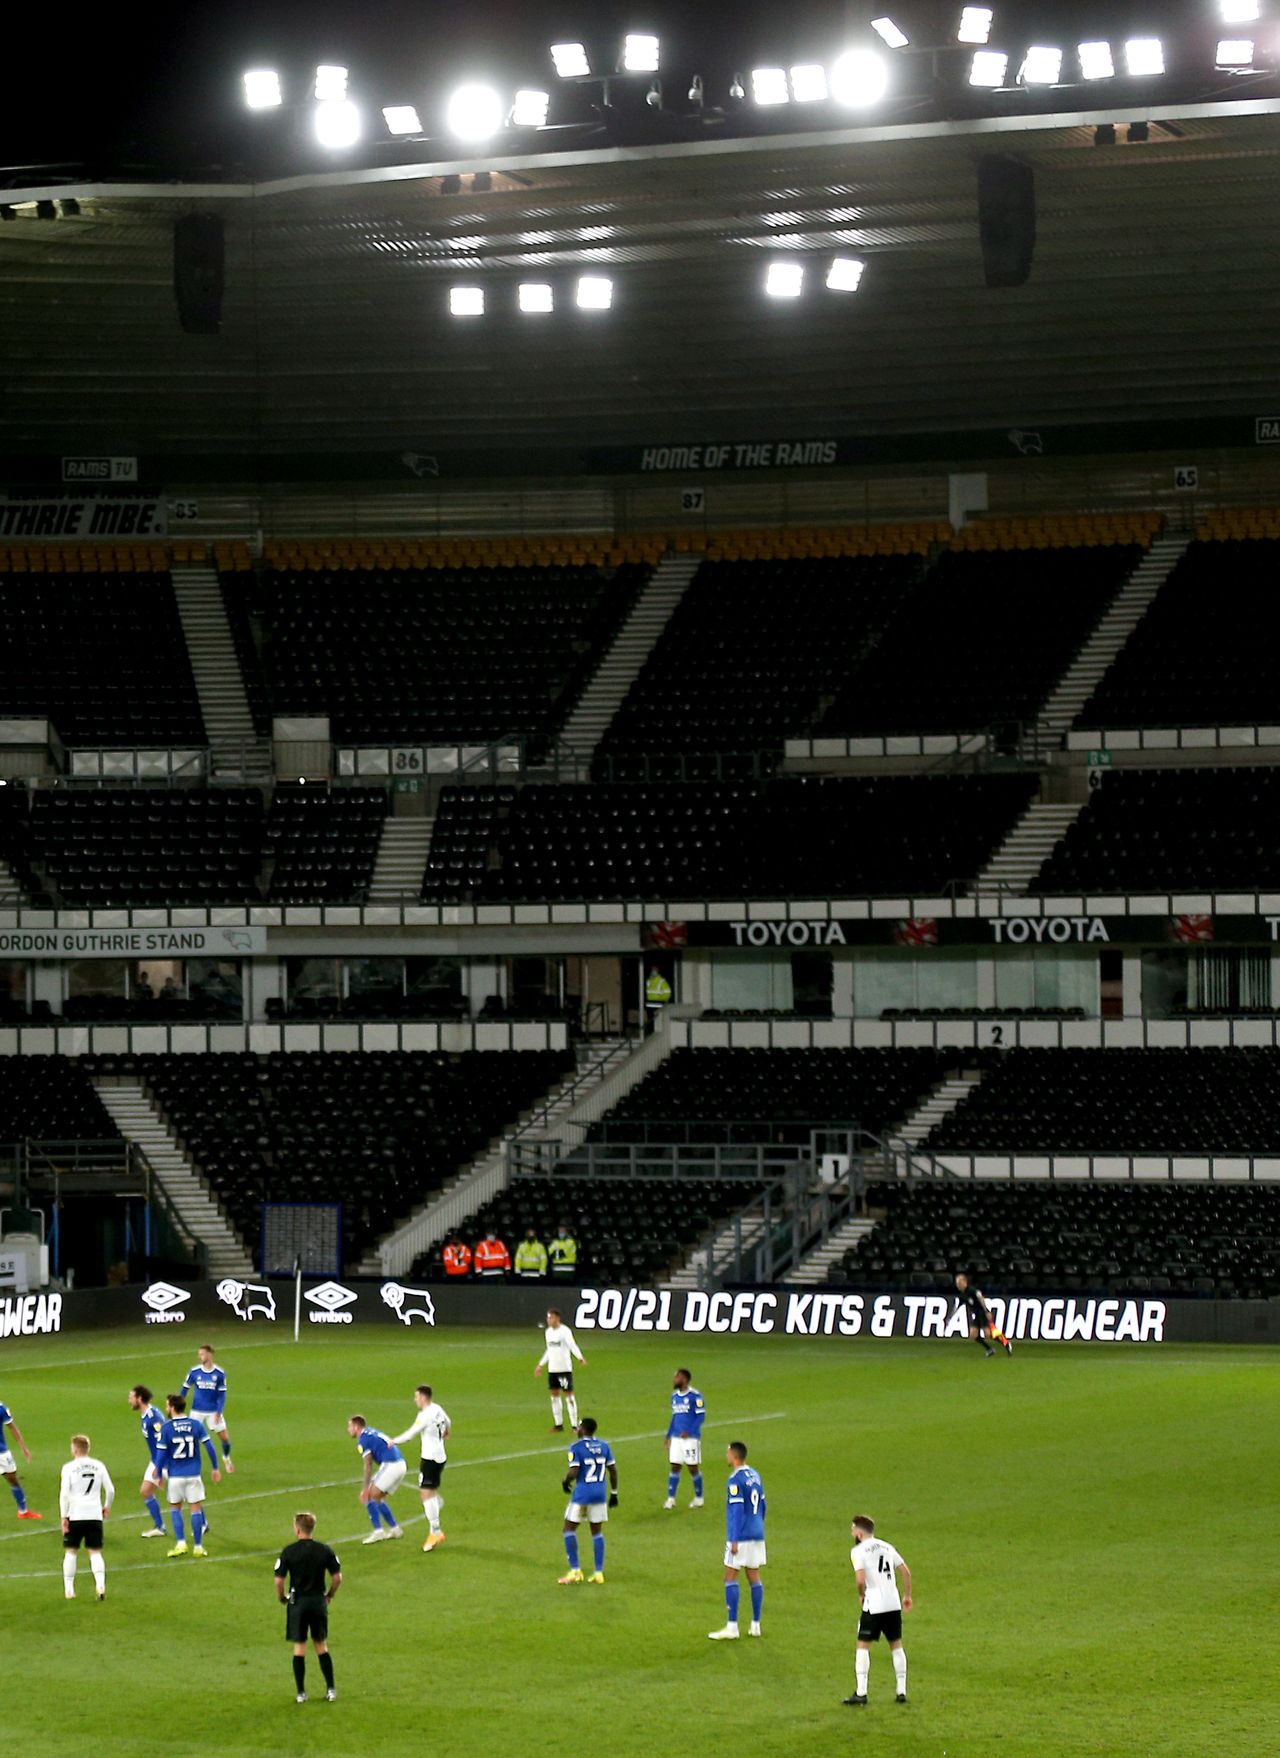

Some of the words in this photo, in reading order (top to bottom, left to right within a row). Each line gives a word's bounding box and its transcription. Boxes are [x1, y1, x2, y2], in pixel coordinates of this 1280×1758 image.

[641, 446, 702, 470] HOME
[703, 445, 732, 468] OF
[733, 443, 774, 467] THE
[774, 441, 838, 465] RAMS
[67, 461, 109, 477] RAMS
[1177, 471, 1196, 487] 65
[175, 503, 197, 519] 85
[683, 494, 702, 509] 87
[395, 753, 419, 771] 86
[730, 921, 848, 946] TOYOTA
[989, 917, 1111, 943] TOYOTA
[63, 933, 141, 951] GUTHRIE
[146, 932, 206, 950] STAND
[990, 1025, 1003, 1045] 2
[310, 1310, 353, 1324] umbro
[575, 1288, 671, 1333] 20/21
[682, 1290, 778, 1335] DCFC
[785, 1293, 866, 1336] KITS
[870, 1294, 895, 1337] &
[172, 1436, 195, 1459] 21
[584, 1456, 606, 1483] 27
[82, 1473, 95, 1496] 7
[750, 1489, 759, 1515] 9
